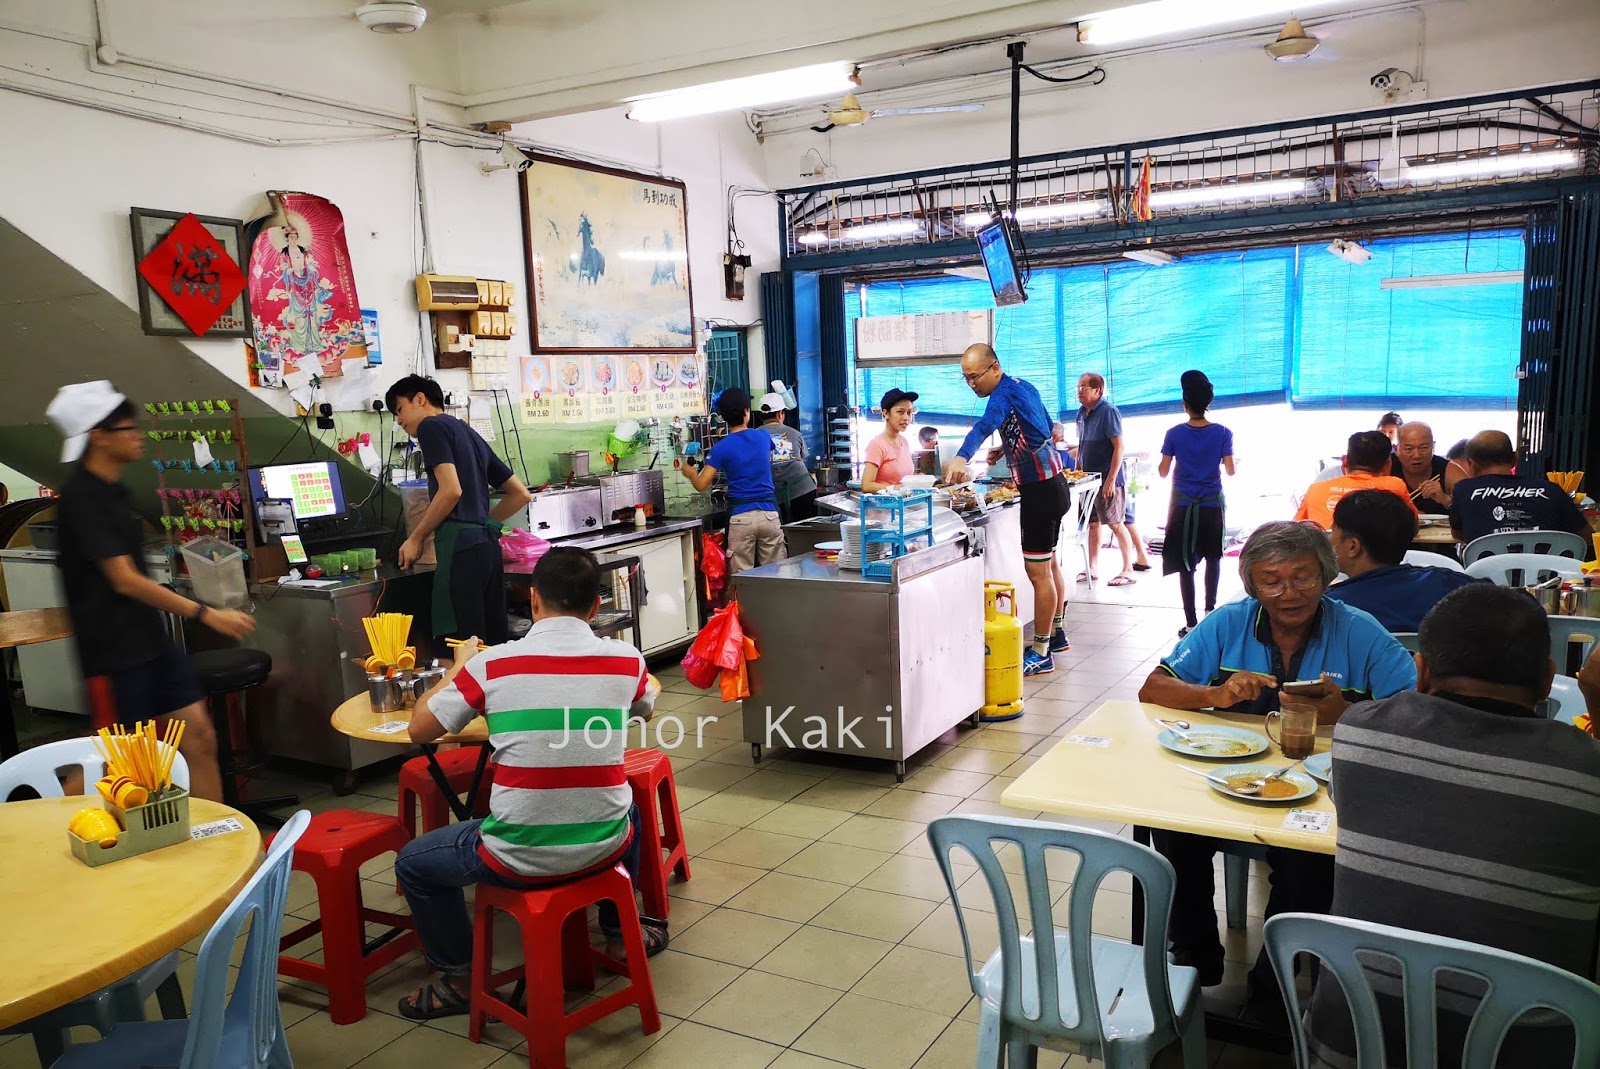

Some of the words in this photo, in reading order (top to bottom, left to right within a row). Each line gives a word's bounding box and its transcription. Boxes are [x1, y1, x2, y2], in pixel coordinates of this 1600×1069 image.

[643, 188, 678, 209] 馬到功成
[1470, 486, 1550, 501] FINISHER
